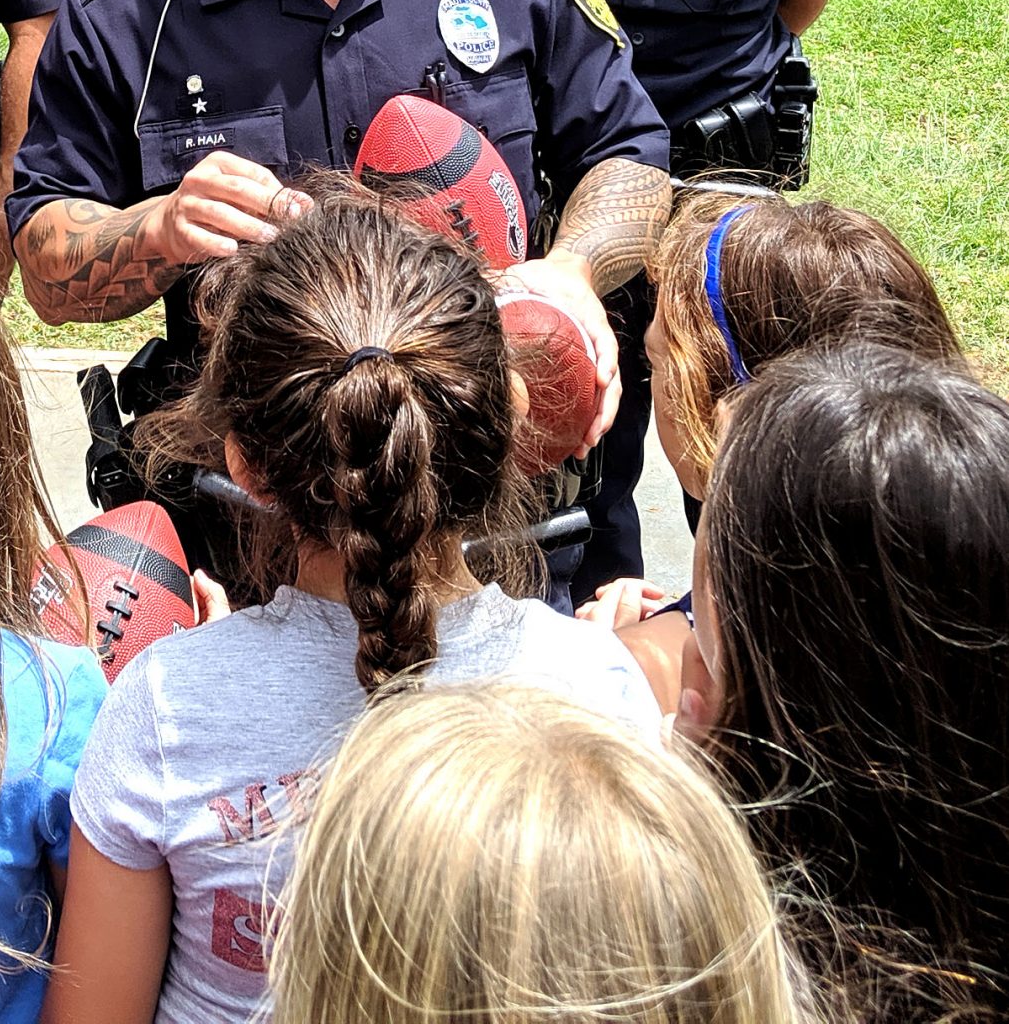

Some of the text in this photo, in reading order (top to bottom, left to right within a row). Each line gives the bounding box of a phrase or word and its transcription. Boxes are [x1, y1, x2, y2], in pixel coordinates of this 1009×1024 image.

[456, 39, 496, 53] POLICE
[185, 133, 226, 149] R. HAJA
